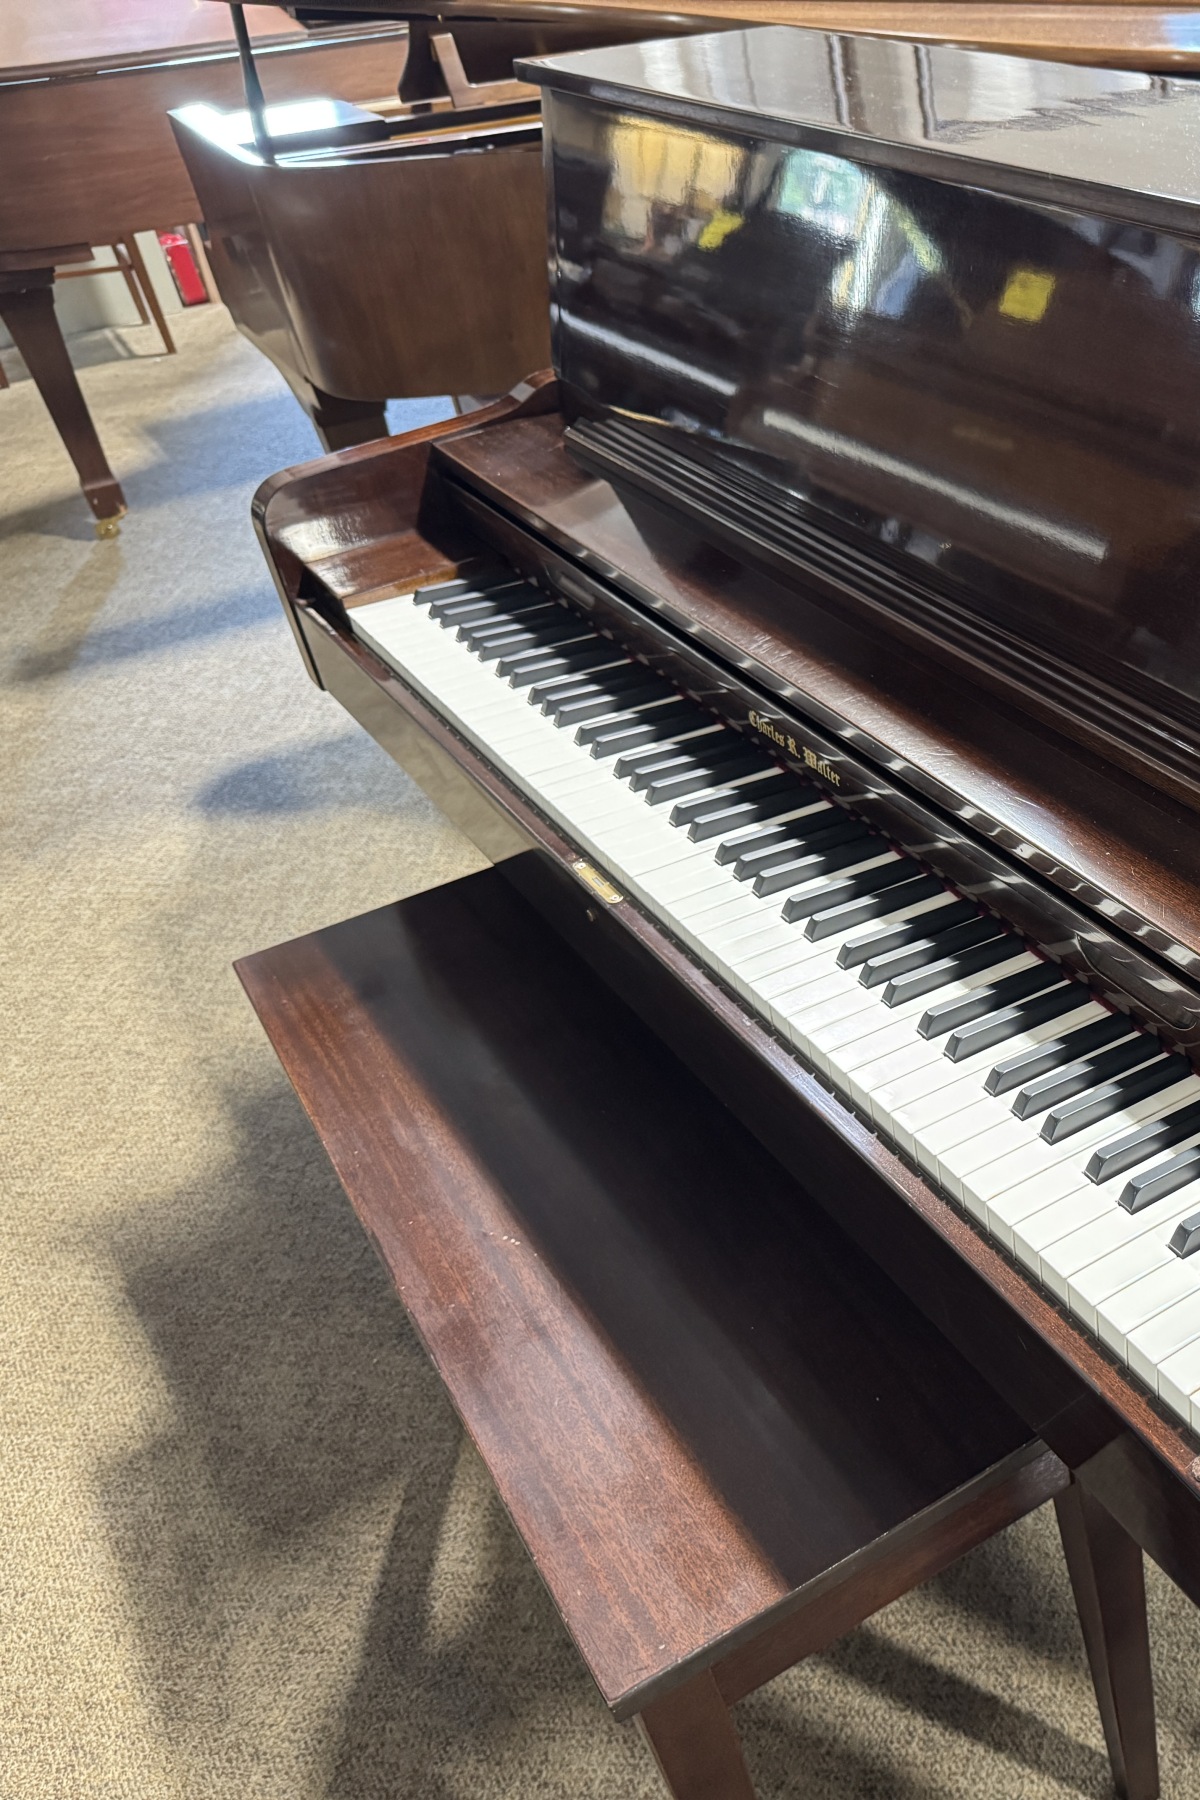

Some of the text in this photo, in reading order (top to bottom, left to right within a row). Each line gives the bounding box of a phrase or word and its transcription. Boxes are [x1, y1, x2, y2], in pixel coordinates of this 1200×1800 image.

[748, 710, 841, 787] Charles R. Walter
